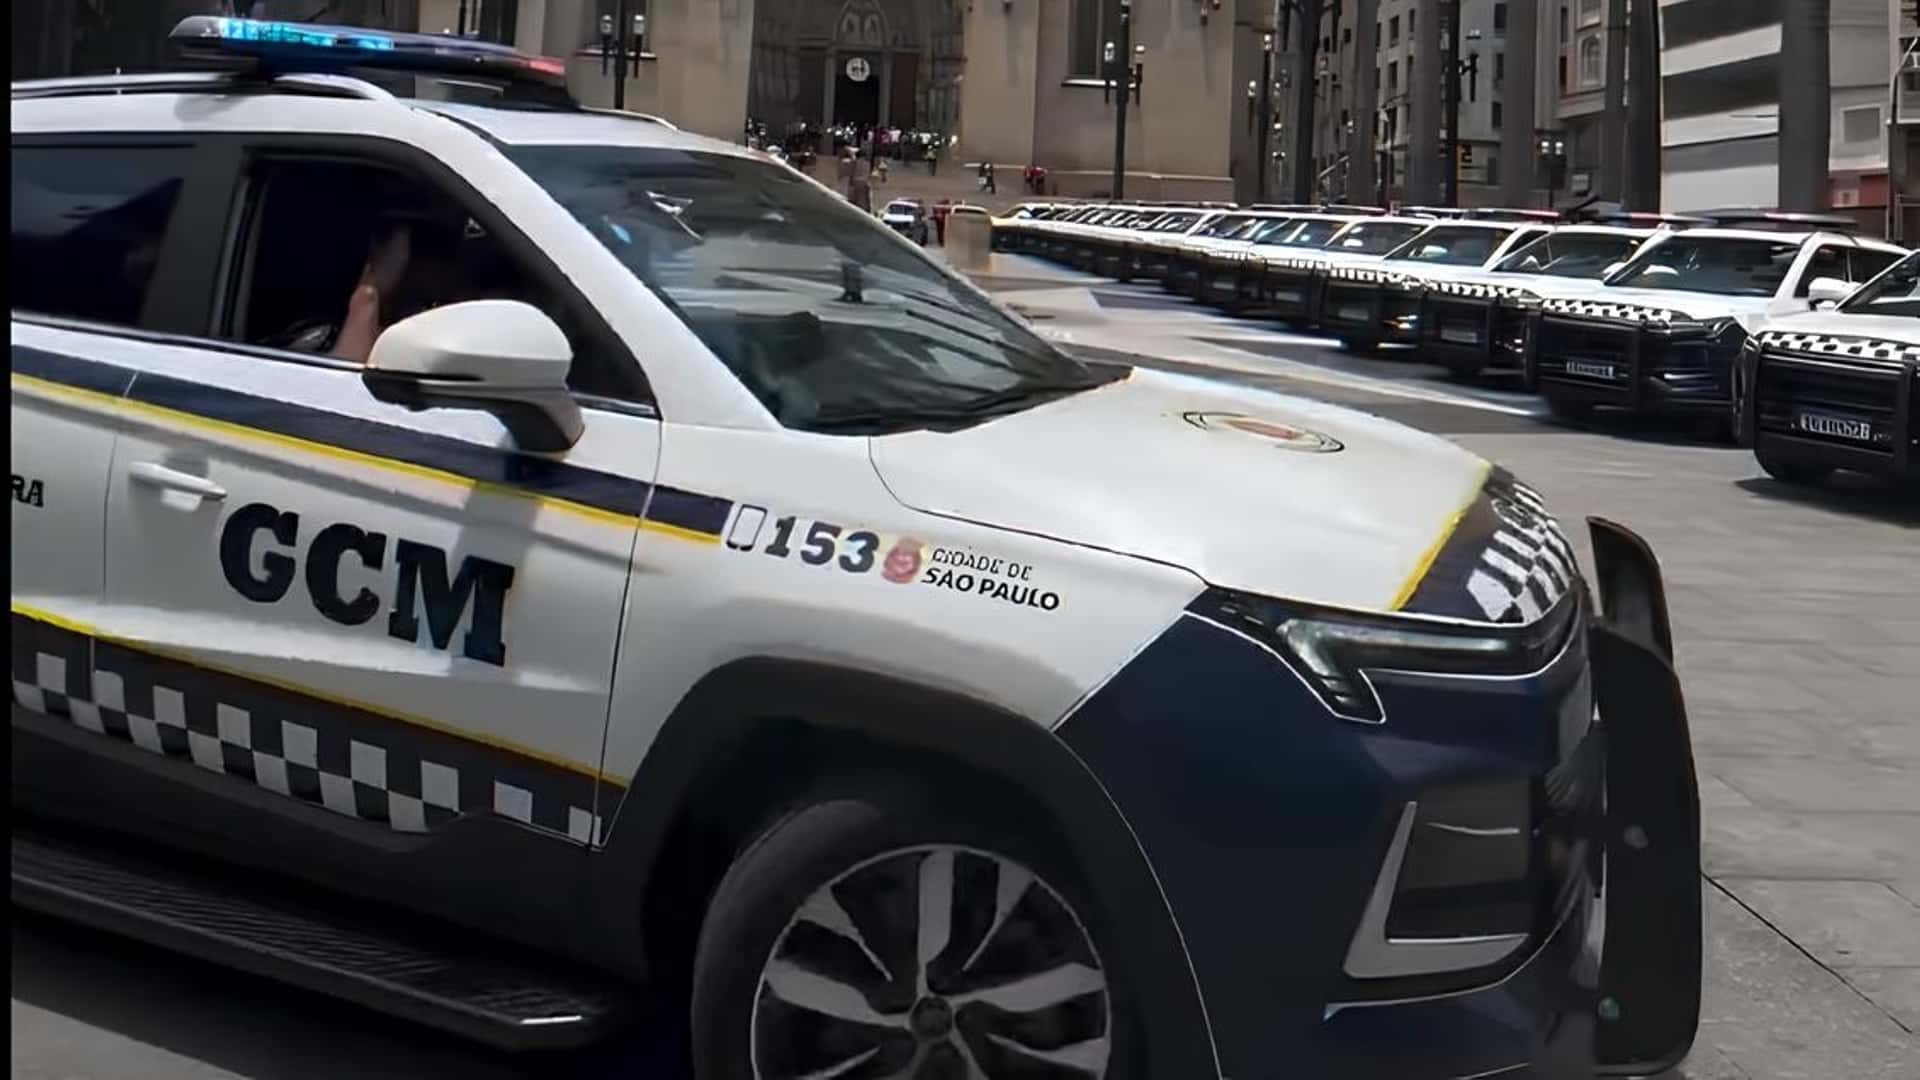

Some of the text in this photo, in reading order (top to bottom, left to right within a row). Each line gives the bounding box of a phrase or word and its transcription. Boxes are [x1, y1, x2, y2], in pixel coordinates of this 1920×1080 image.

[764, 516, 880, 573] 153
[932, 548, 1032, 581] CIDADE DE
[219, 503, 515, 666] GCM
[978, 578, 1060, 611] PAULO
